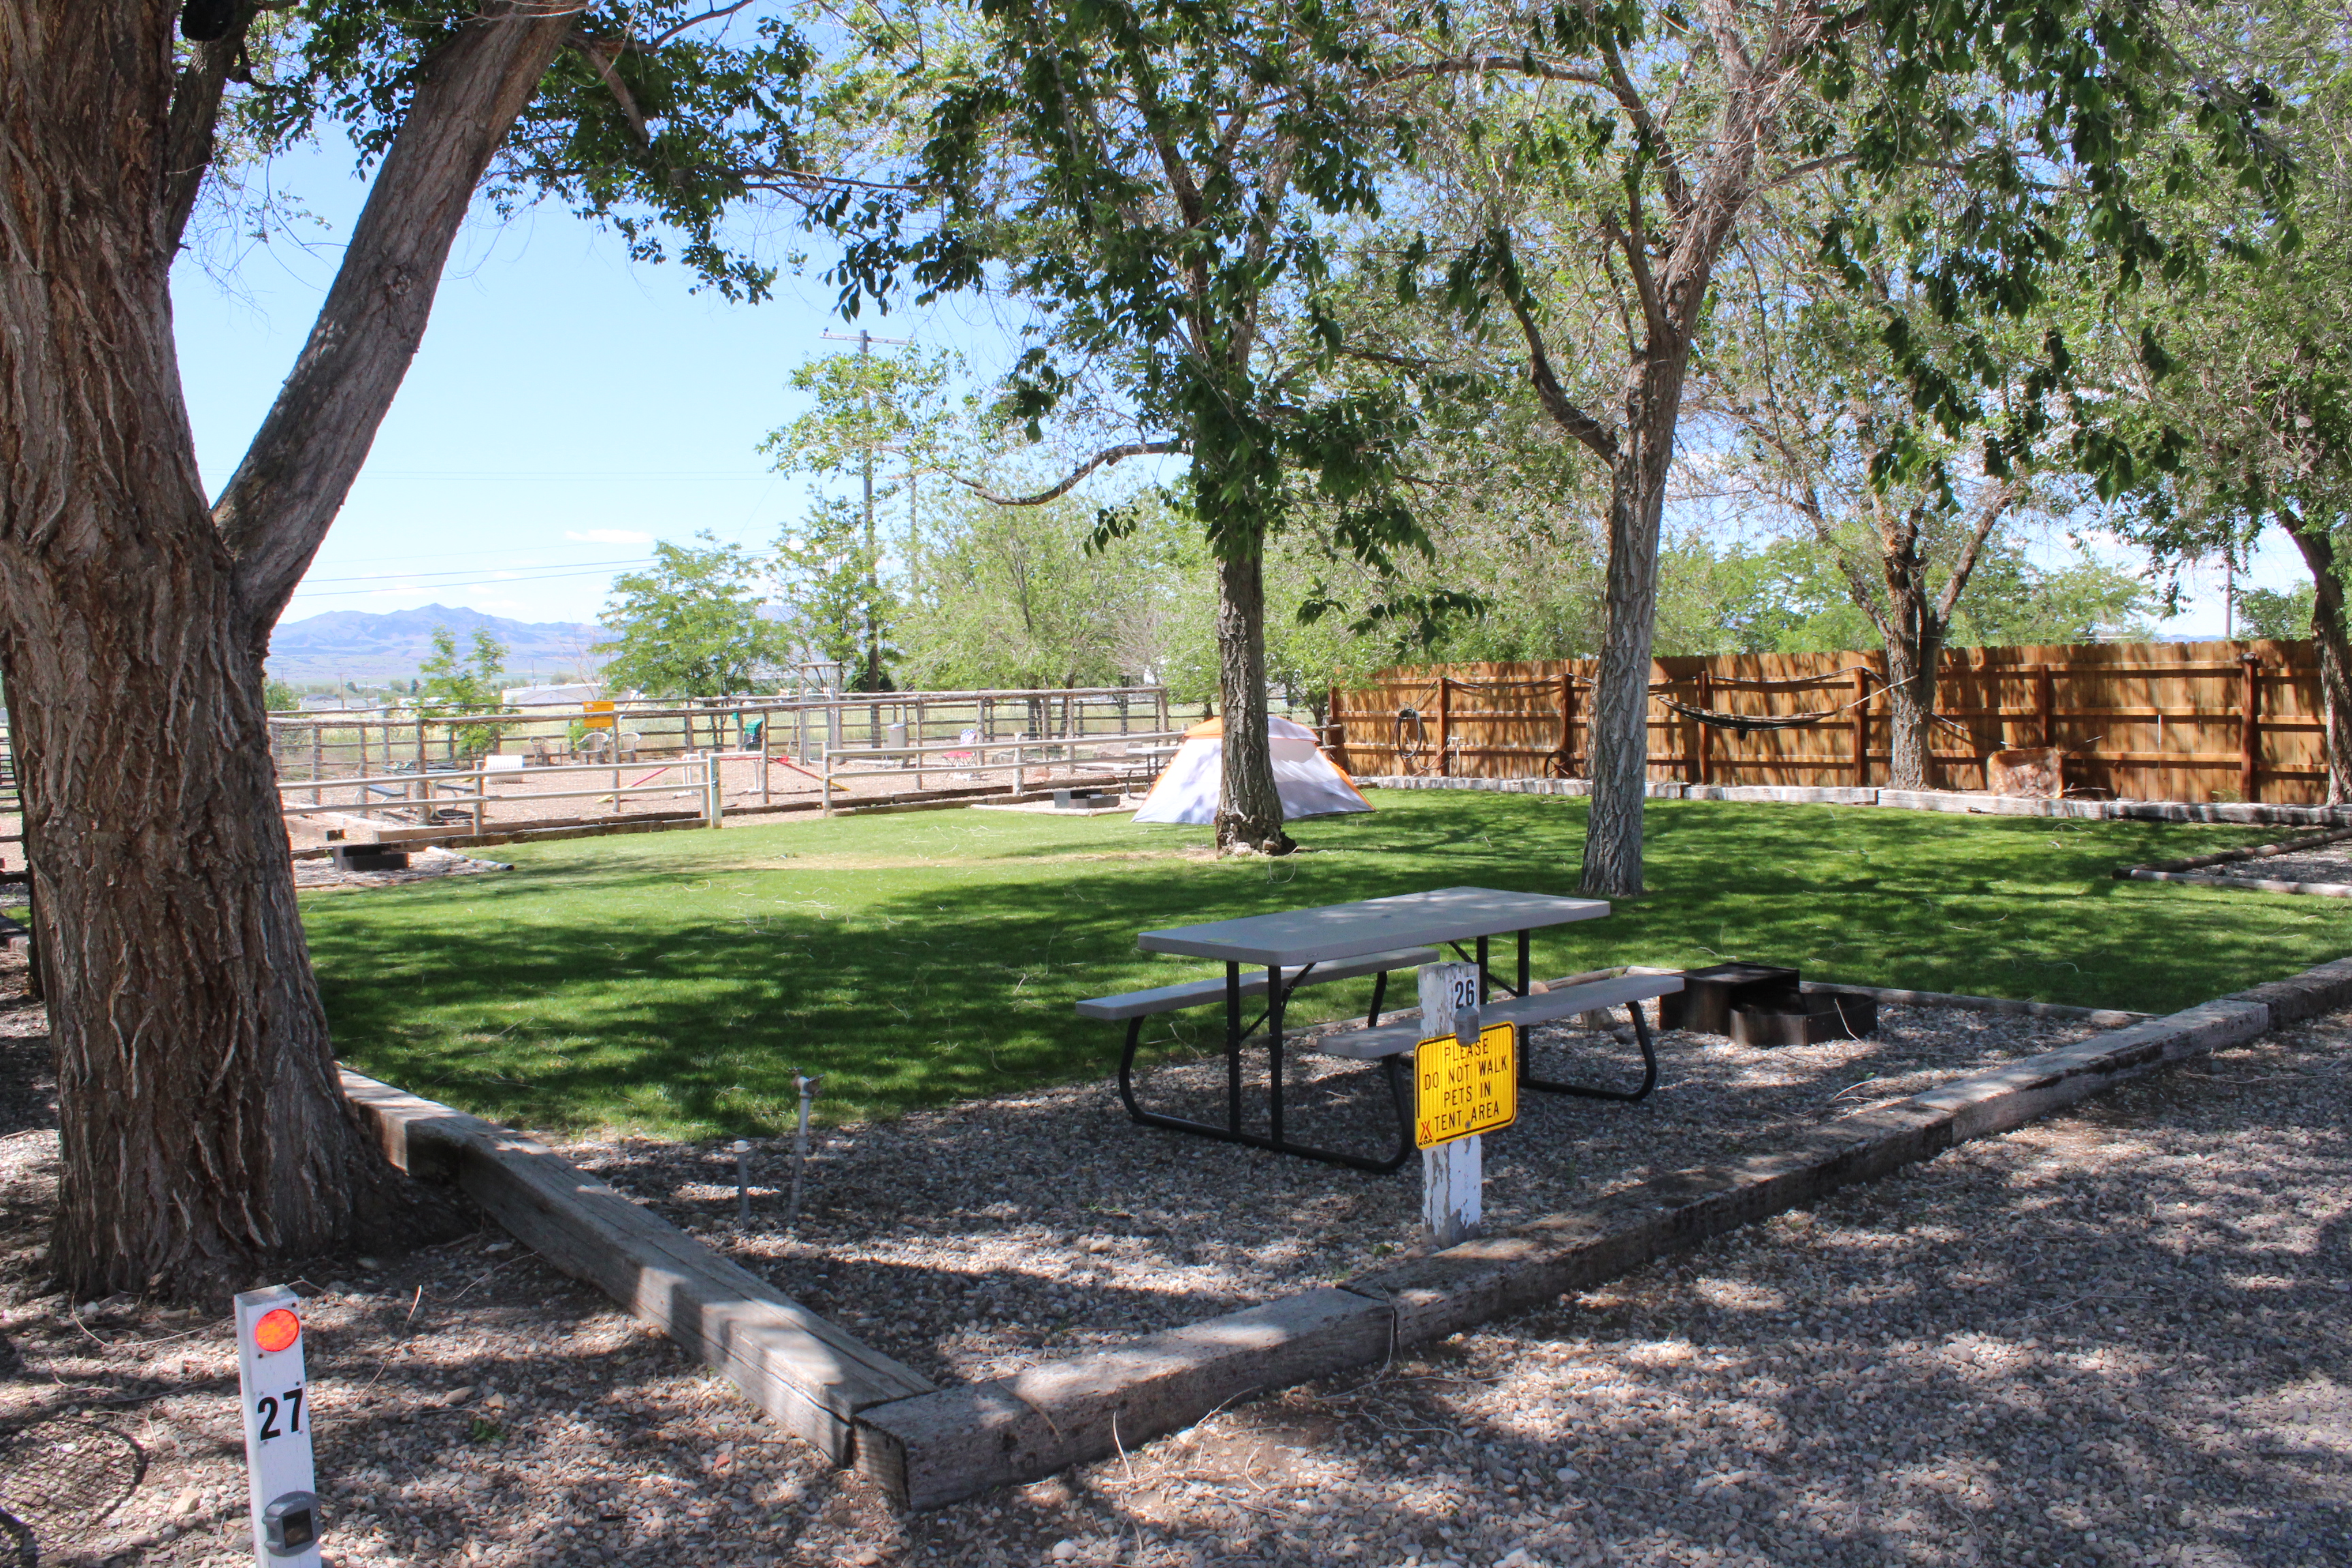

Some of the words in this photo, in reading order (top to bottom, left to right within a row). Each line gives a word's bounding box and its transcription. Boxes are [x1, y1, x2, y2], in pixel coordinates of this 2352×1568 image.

[1454, 979, 1475, 1009] 26
[1445, 1038, 1489, 1064] PLEASE
[1424, 1074, 1439, 1091] DO
[1448, 1064, 1470, 1082] NOT
[1478, 1055, 1508, 1077] WALK
[1443, 1085, 1472, 1108] PETS
[1480, 1081, 1491, 1098] IN
[1434, 1110, 1463, 1133] TENT
[1471, 1100, 1500, 1124] AREA
[257, 1388, 304, 1441] 27
